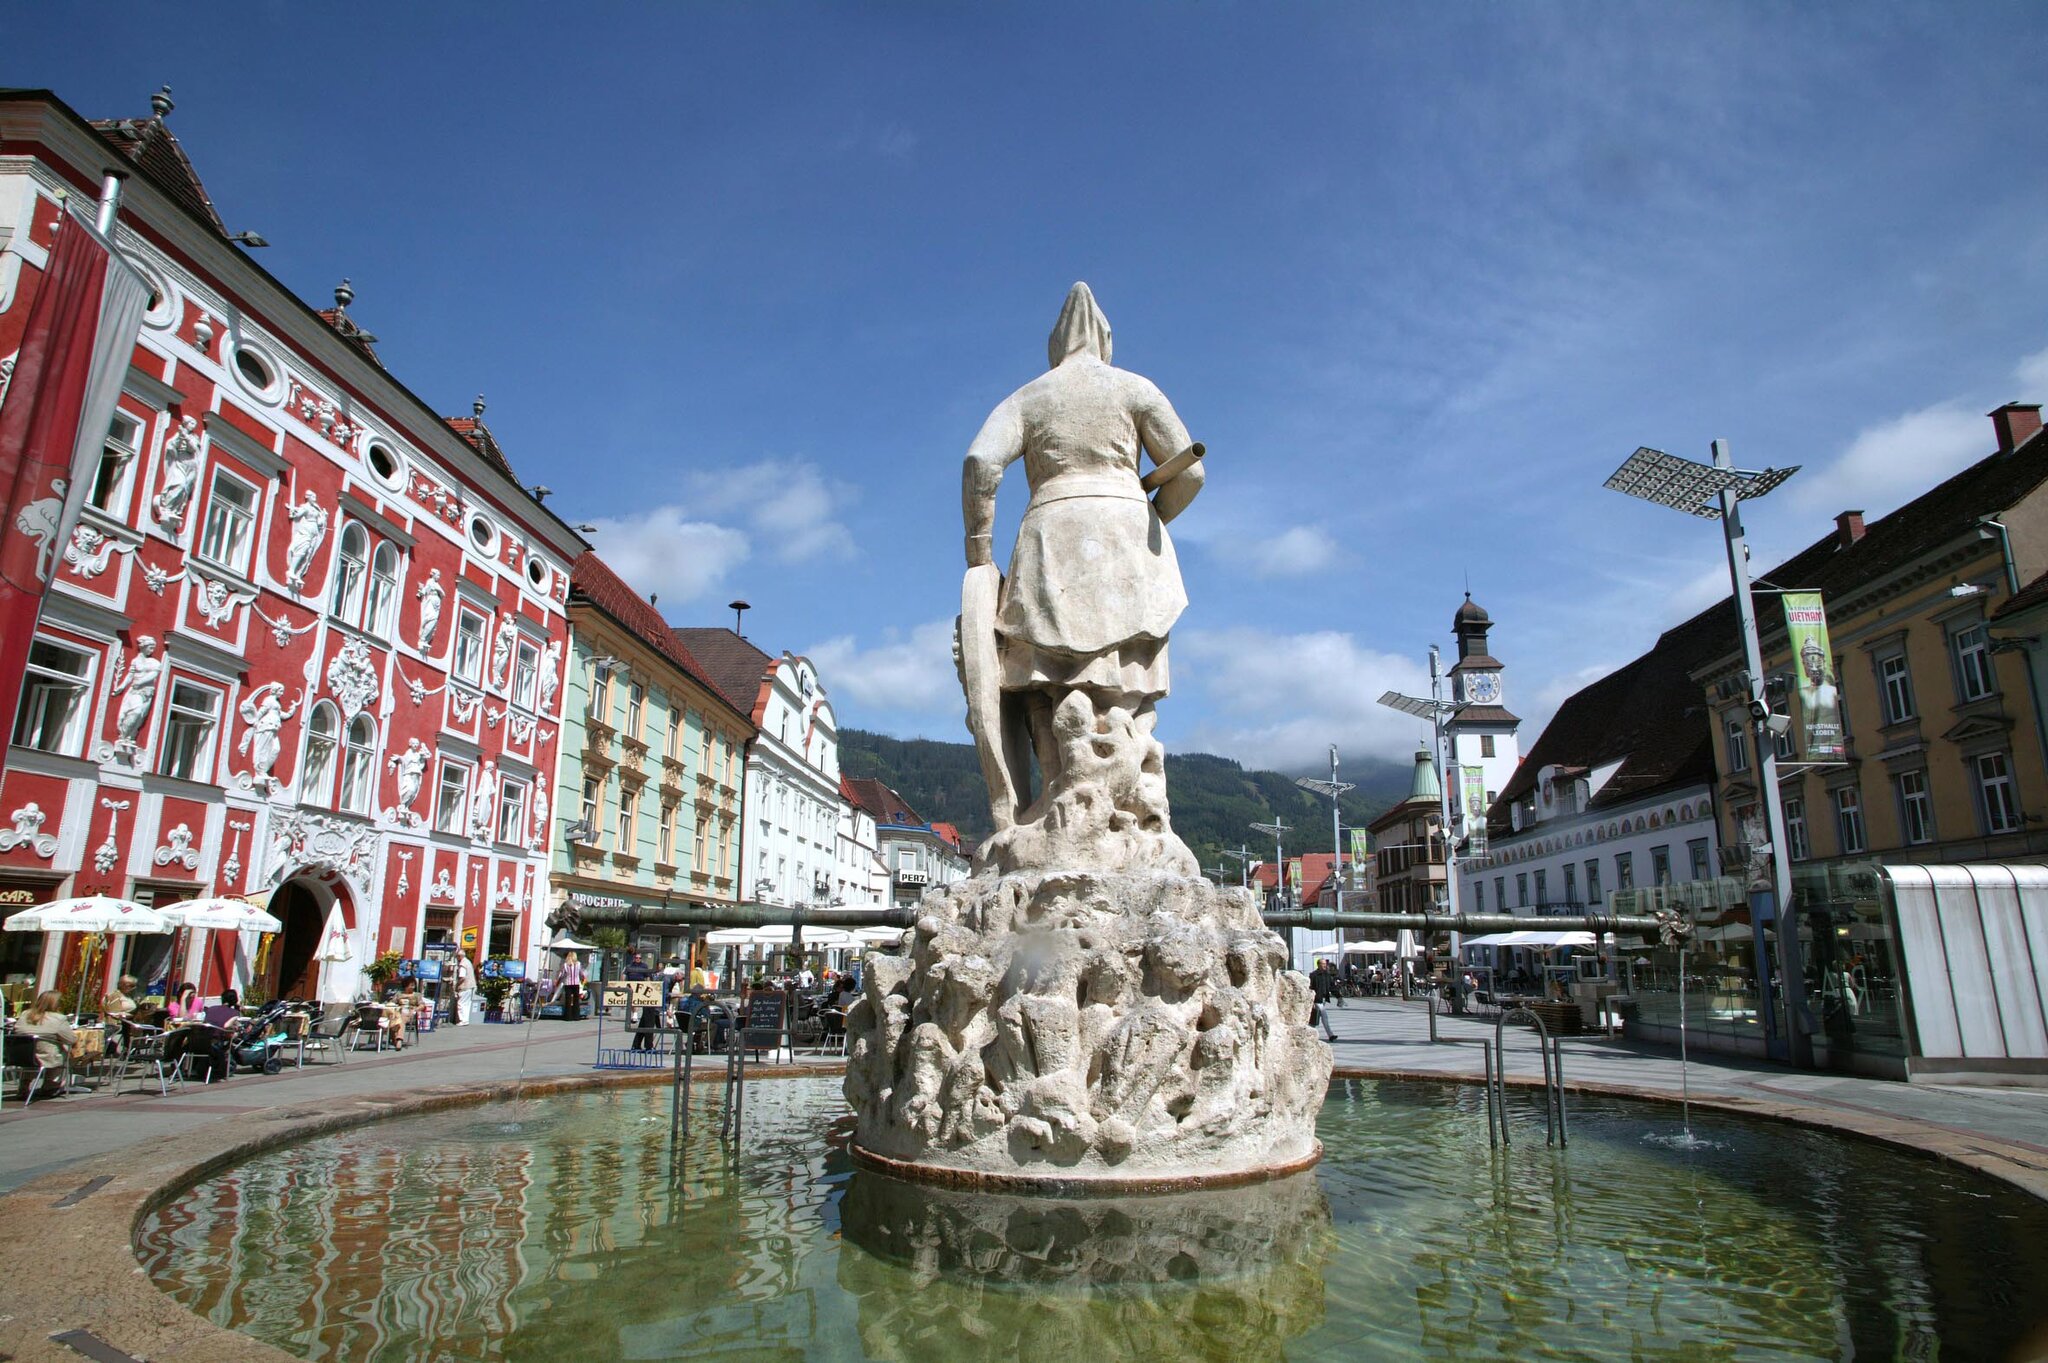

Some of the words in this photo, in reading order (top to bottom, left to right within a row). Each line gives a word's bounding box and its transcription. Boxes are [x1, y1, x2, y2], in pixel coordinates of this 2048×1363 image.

[1788, 611, 1823, 622] VIETNAM
[901, 873, 926, 883] PERZ
[614, 983, 653, 998] CFE
[607, 997, 658, 1006] Steincherer
